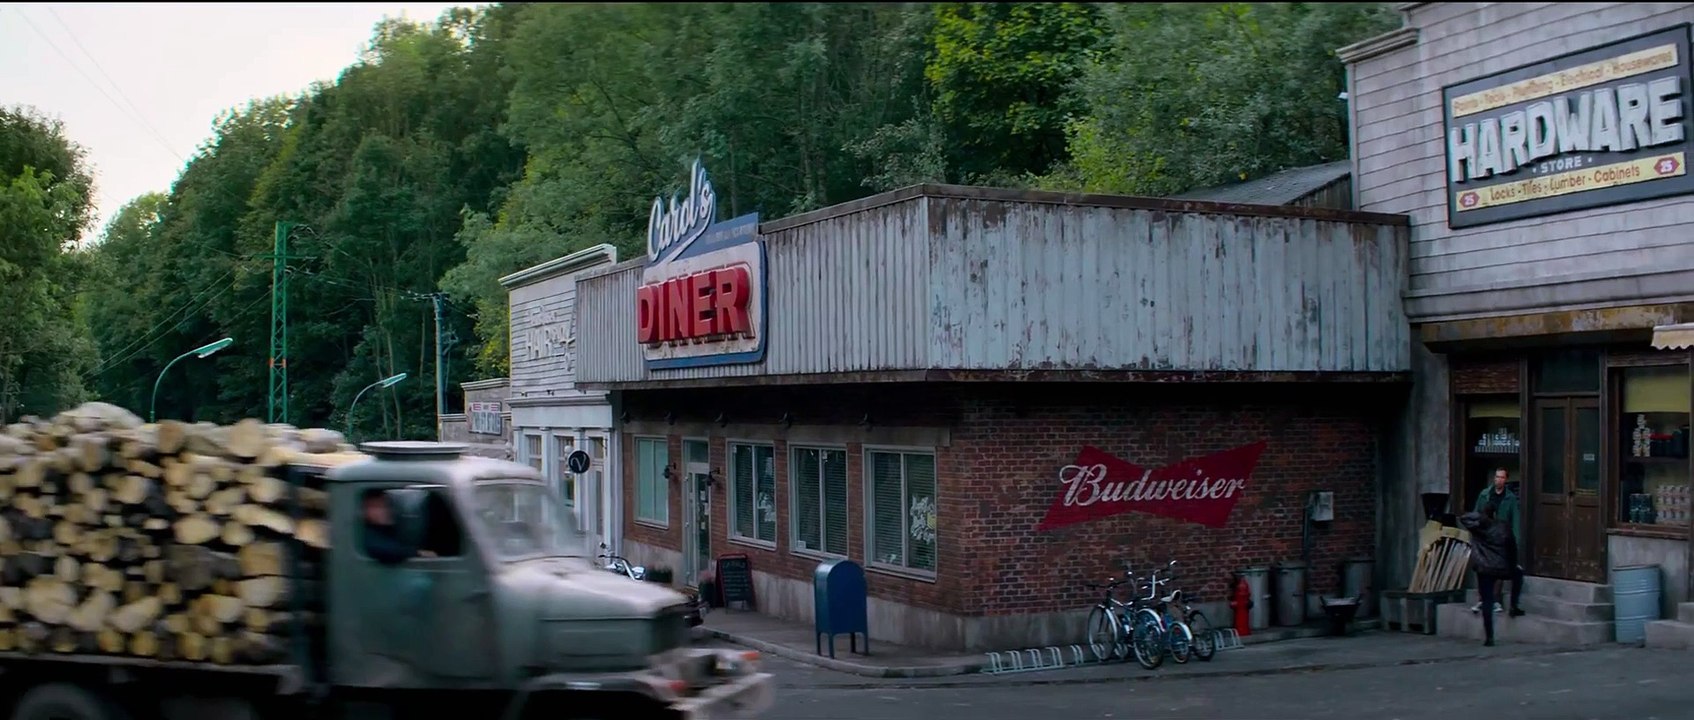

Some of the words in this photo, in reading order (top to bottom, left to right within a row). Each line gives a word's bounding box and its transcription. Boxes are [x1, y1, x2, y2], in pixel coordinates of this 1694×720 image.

[1451, 76, 1685, 183] HARDWARE
[1490, 187, 1515, 201] Locks
[1522, 181, 1542, 195] Tiles
[1550, 174, 1585, 190] Lumber
[1594, 164, 1641, 183] Cabinets
[1541, 156, 1582, 173] STORE
[1660, 160, 1673, 172] 25
[648, 158, 716, 262] Carol's
[637, 266, 753, 344] DINER
[1059, 463, 1245, 506] Budweiser
